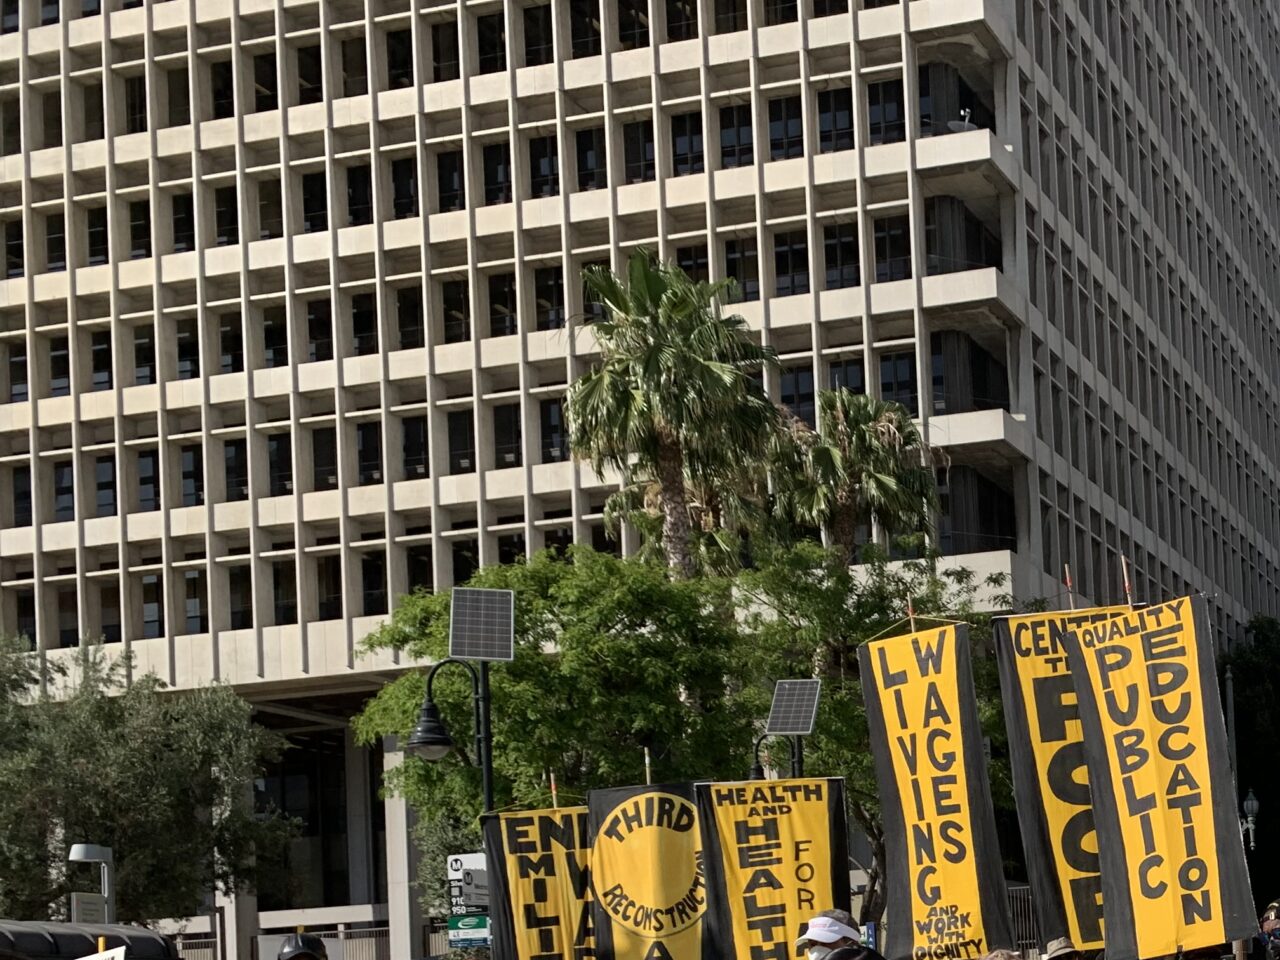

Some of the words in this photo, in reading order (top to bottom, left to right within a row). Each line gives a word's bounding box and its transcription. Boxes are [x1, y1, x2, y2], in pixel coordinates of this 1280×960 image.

[1014, 611, 1124, 658] CEN
[1081, 600, 1187, 650] QUALITY
[911, 629, 967, 864] WAGES
[715, 783, 824, 807] HEALTH
[878, 646, 942, 906] LIVING
[1094, 644, 1169, 900] PUBLIC
[1139, 624, 1213, 926] EDUCATION
[603, 796, 695, 844] THIRD
[747, 804, 793, 818] AND
[601, 850, 707, 932] RECONSTRUCTION
[794, 840, 815, 911] FOR
[452, 906, 466, 915] 950
[915, 911, 972, 935] WORK
[926, 904, 959, 919] AND
[926, 930, 966, 945] WITH
